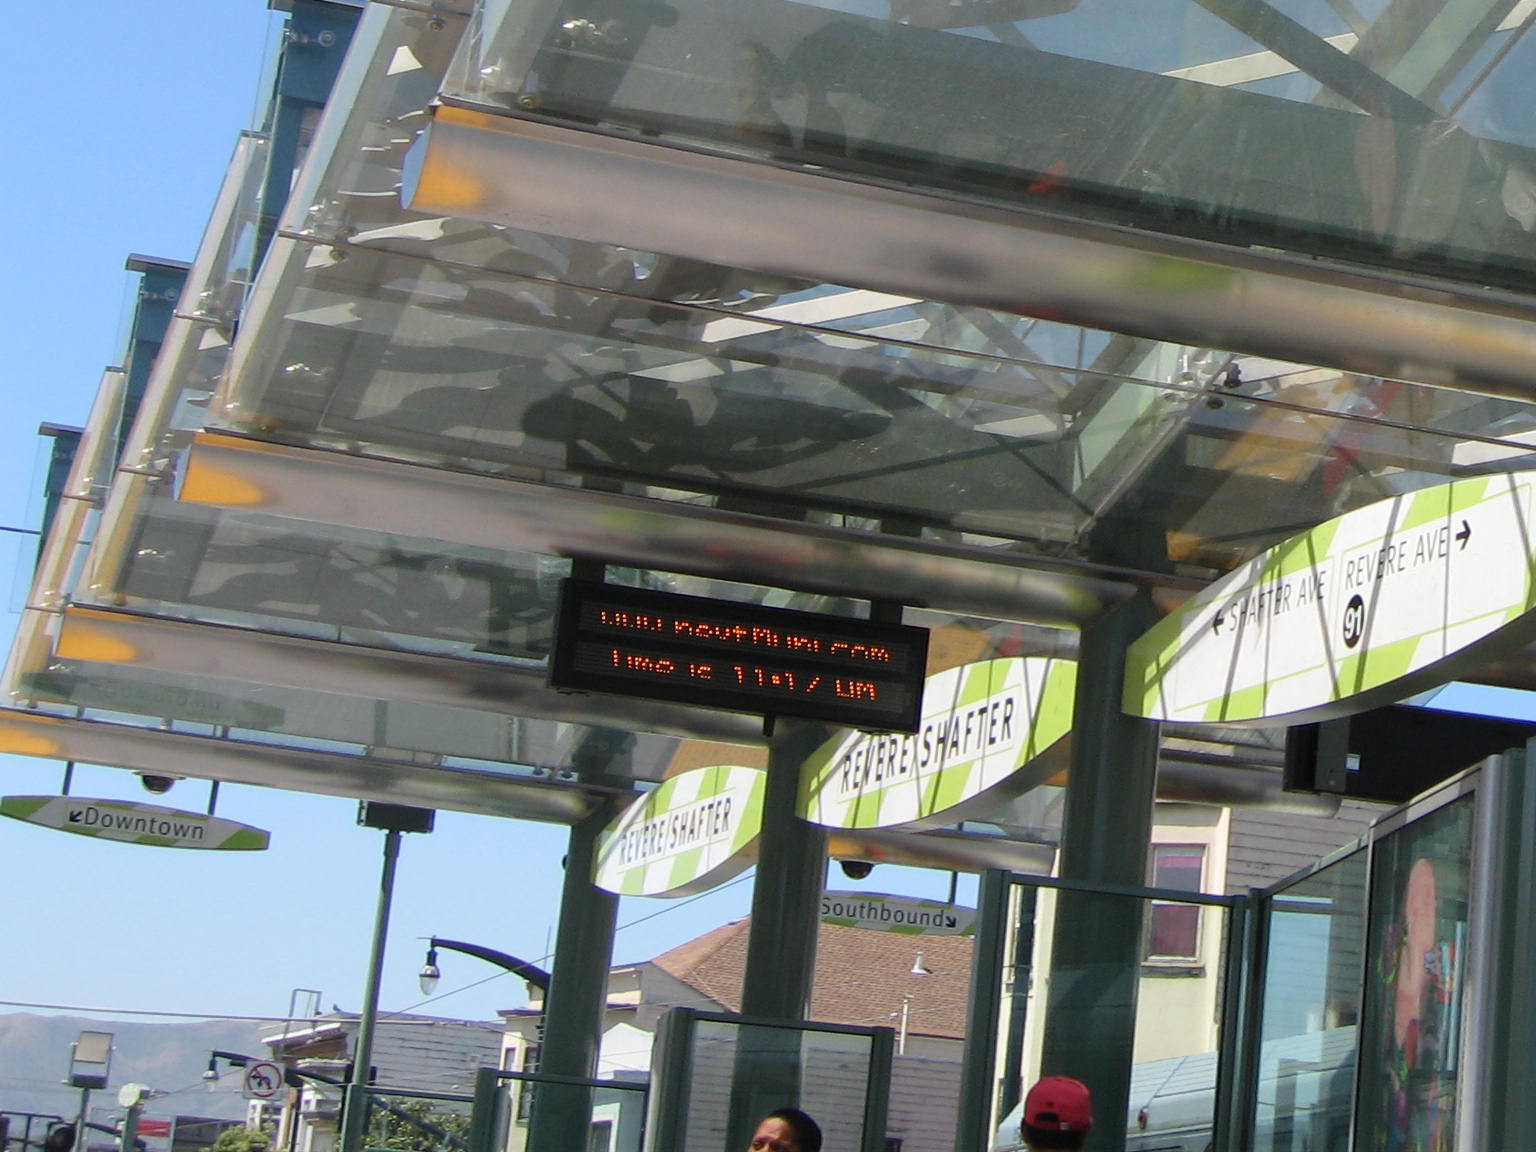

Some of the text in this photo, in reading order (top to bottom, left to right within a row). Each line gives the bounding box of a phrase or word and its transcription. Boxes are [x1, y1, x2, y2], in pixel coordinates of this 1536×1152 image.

[1345, 526, 1450, 591] REVERE AVE
[1229, 570, 1327, 632] SHAFTER AVE
[1344, 605, 1363, 640] 91
[840, 697, 1015, 794] REVERE/SHAFTER
[83, 806, 205, 840] Downtown
[619, 796, 732, 865] REVERE/SHAFTER
[821, 897, 945, 928] Southbound
